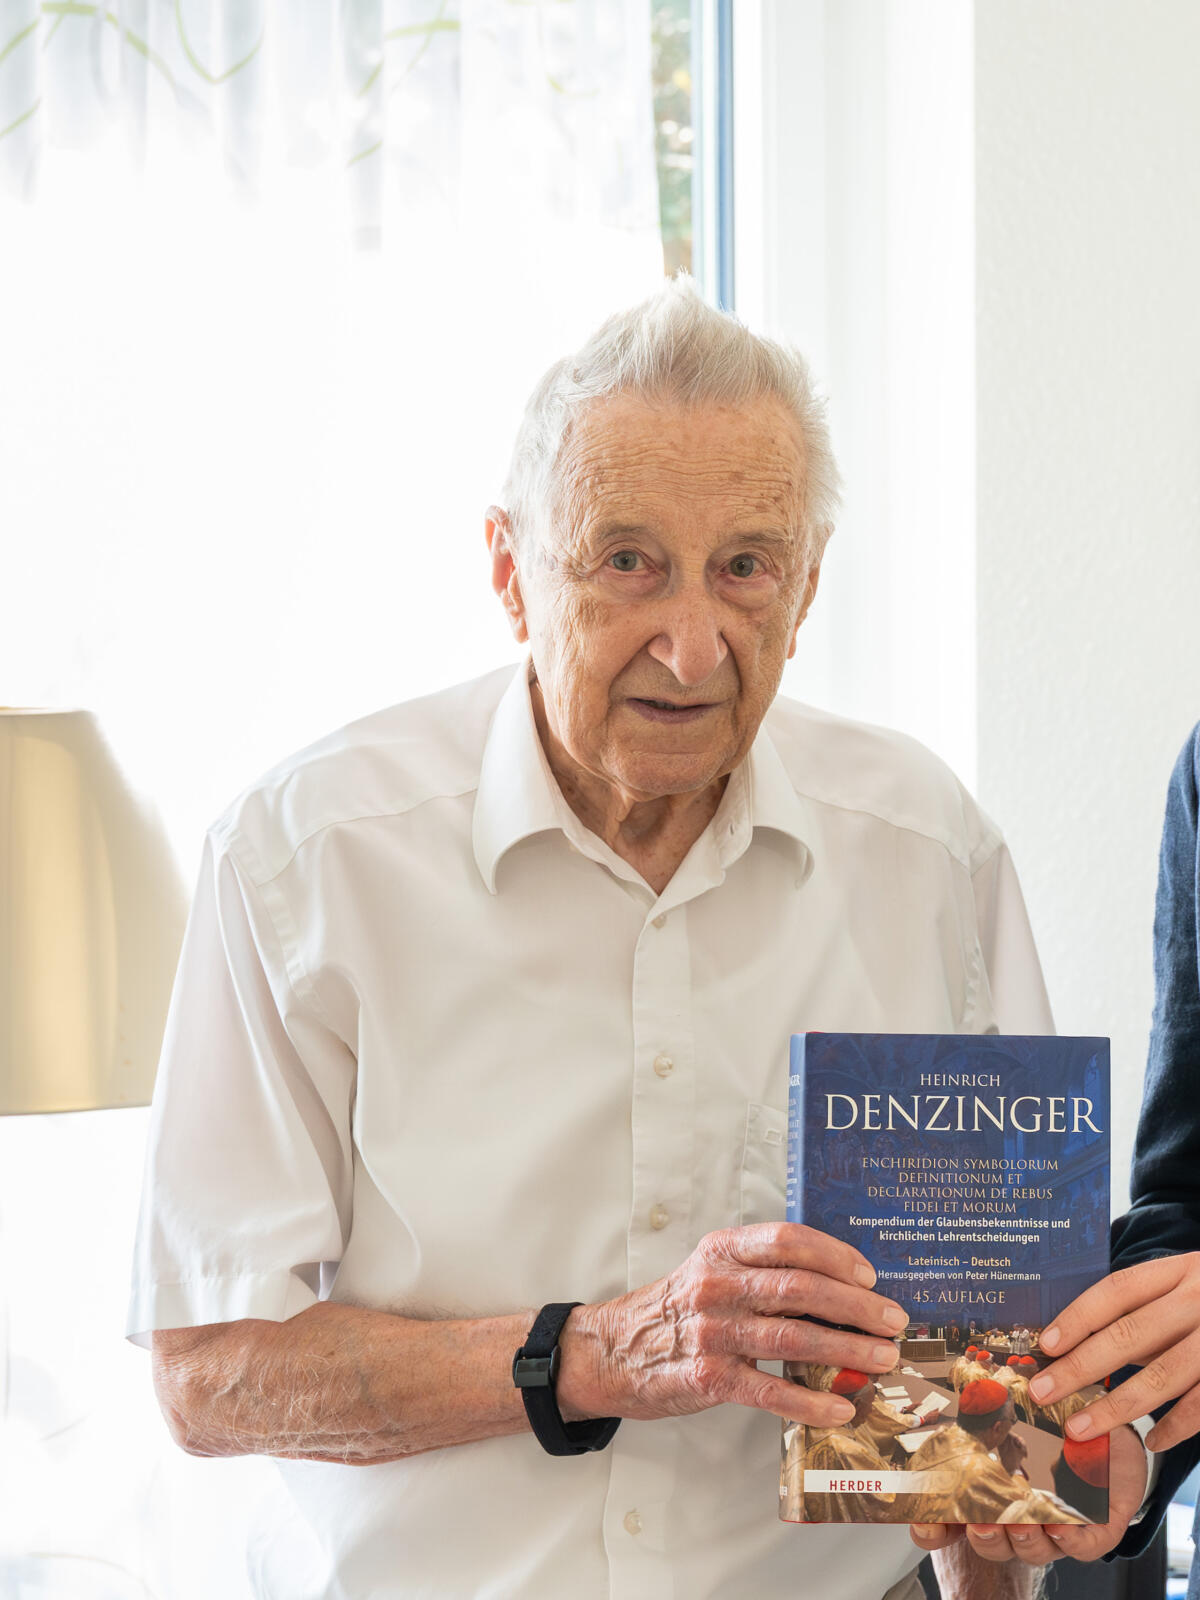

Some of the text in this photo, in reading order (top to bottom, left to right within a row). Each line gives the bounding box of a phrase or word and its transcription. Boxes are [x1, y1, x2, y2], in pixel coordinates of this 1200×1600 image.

[920, 1073, 1001, 1087] HEINRICH
[824, 1093, 1104, 1133] DENZINGER
[862, 1157, 1059, 1171] ENCHIRIDION SYMBOLORUM
[898, 1172, 1023, 1185] DEFINITIONUM ET
[867, 1186, 1053, 1200] DECLARATIONUM DE REBUS
[904, 1201, 1017, 1214] FIDEI ET MORUM
[849, 1215, 1071, 1229] Kompendium der Glaubensbekenntnisse und
[879, 1230, 1040, 1245] kirchlichen Lehrentscheidungen
[908, 1255, 960, 1267] Lateinisch
[971, 1256, 1011, 1267] Deutsch
[878, 1269, 1041, 1282] Herausgegeben von Peter Hünermann
[912, 1290, 1006, 1304] 45. AUFLAGE
[829, 1480, 882, 1492] HERDER
